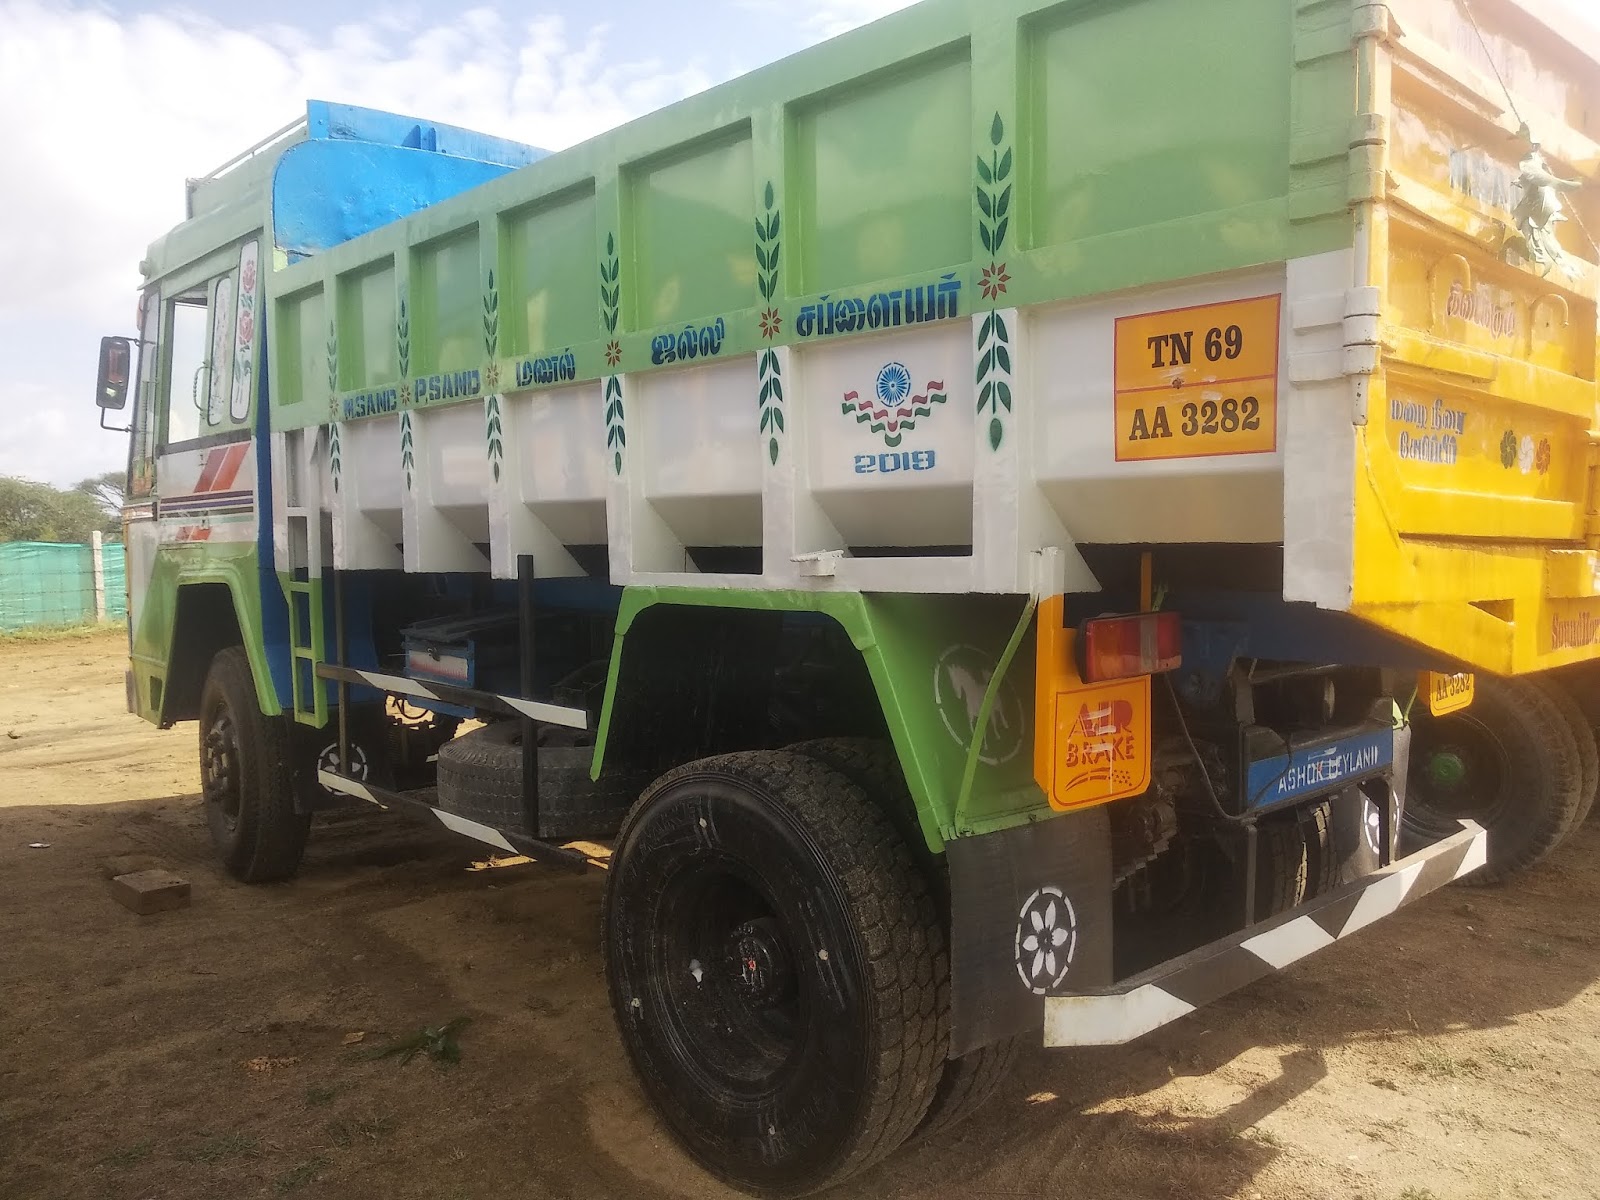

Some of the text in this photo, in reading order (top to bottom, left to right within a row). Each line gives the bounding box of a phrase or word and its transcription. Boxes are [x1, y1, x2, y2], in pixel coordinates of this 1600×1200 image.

[651, 317, 725, 365] ஜல்லி
[1147, 324, 1243, 369] TN 69
[1129, 396, 1261, 441] AA 3282
[854, 449, 936, 474] 2019
